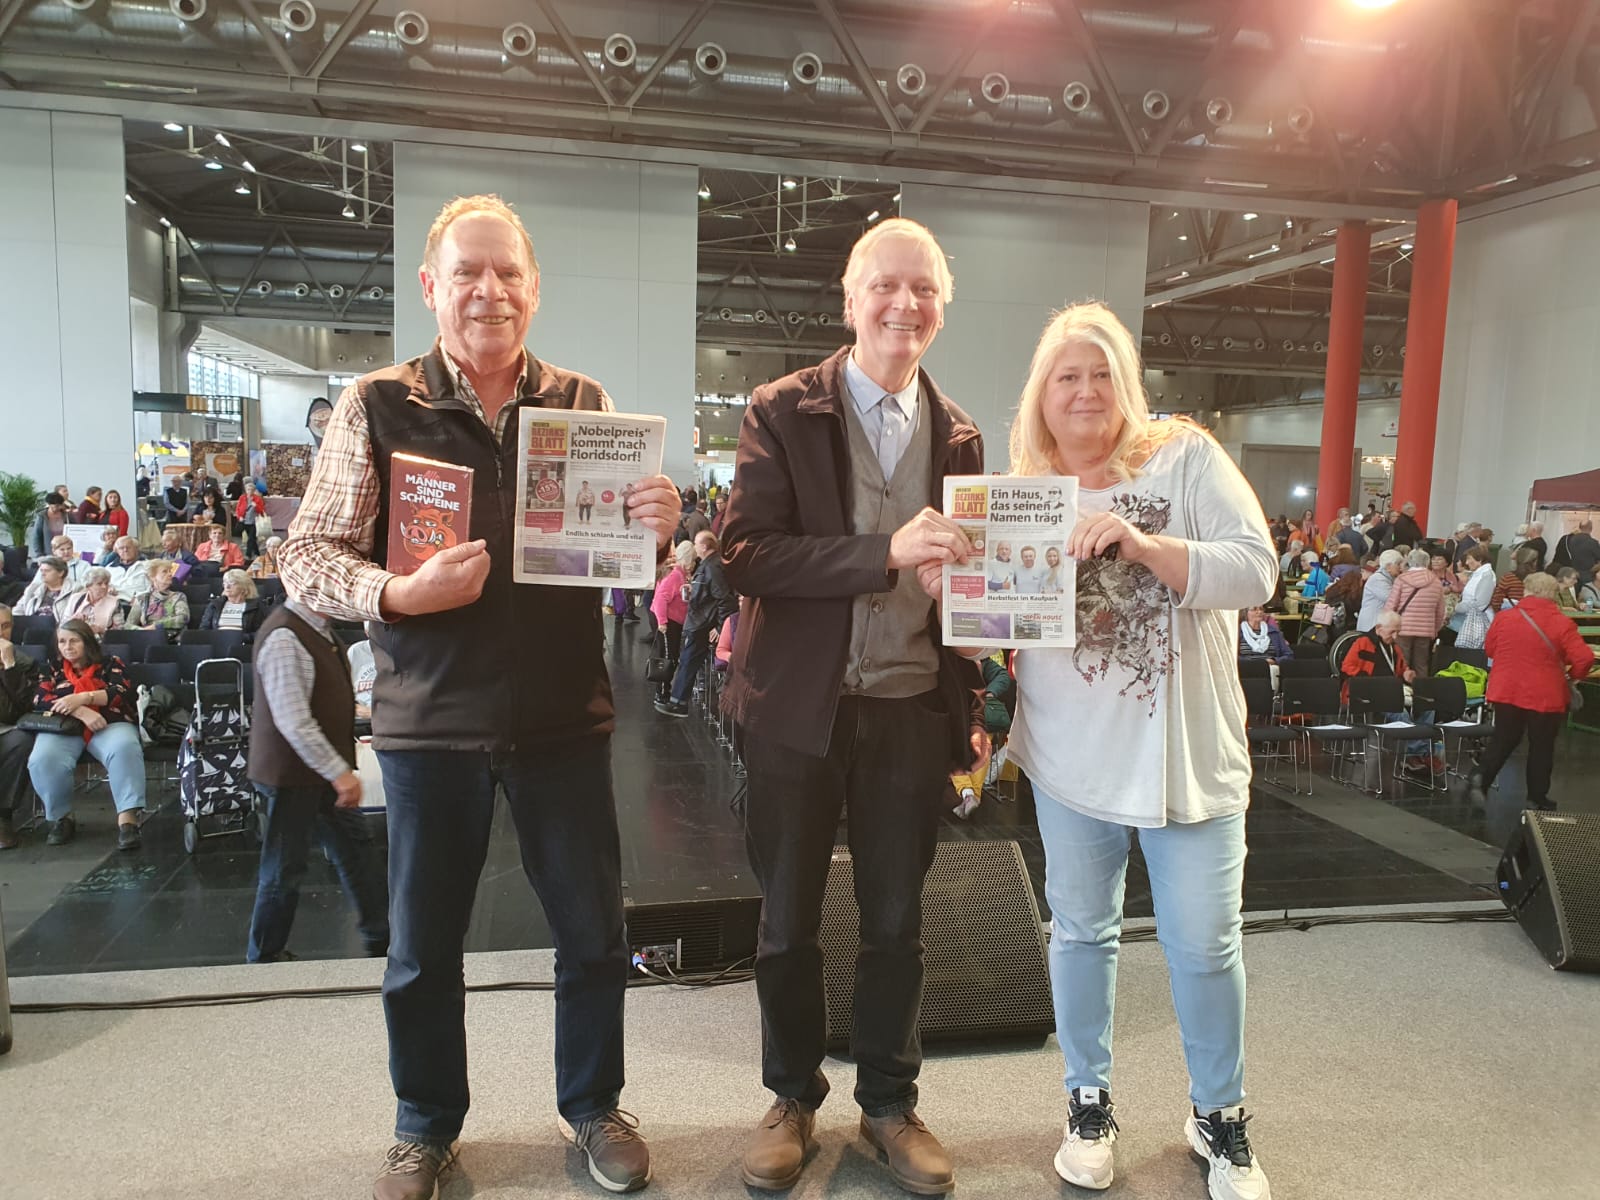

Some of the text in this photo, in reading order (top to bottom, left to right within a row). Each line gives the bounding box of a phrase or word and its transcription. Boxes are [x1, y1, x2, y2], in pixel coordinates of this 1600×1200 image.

[531, 437, 565, 449] BLATT
[571, 437, 647, 450] kommt nach
[570, 449, 641, 462] Floridsdorf!
[405, 473, 456, 492] MÄNNER
[416, 485, 444, 499] SIND
[991, 489, 1043, 501] Ein Haus,
[399, 491, 460, 511] SCHWEINE
[954, 501, 985, 513] BLATT
[991, 500, 1051, 511] das seinen
[990, 513, 1063, 525] Namen trägt
